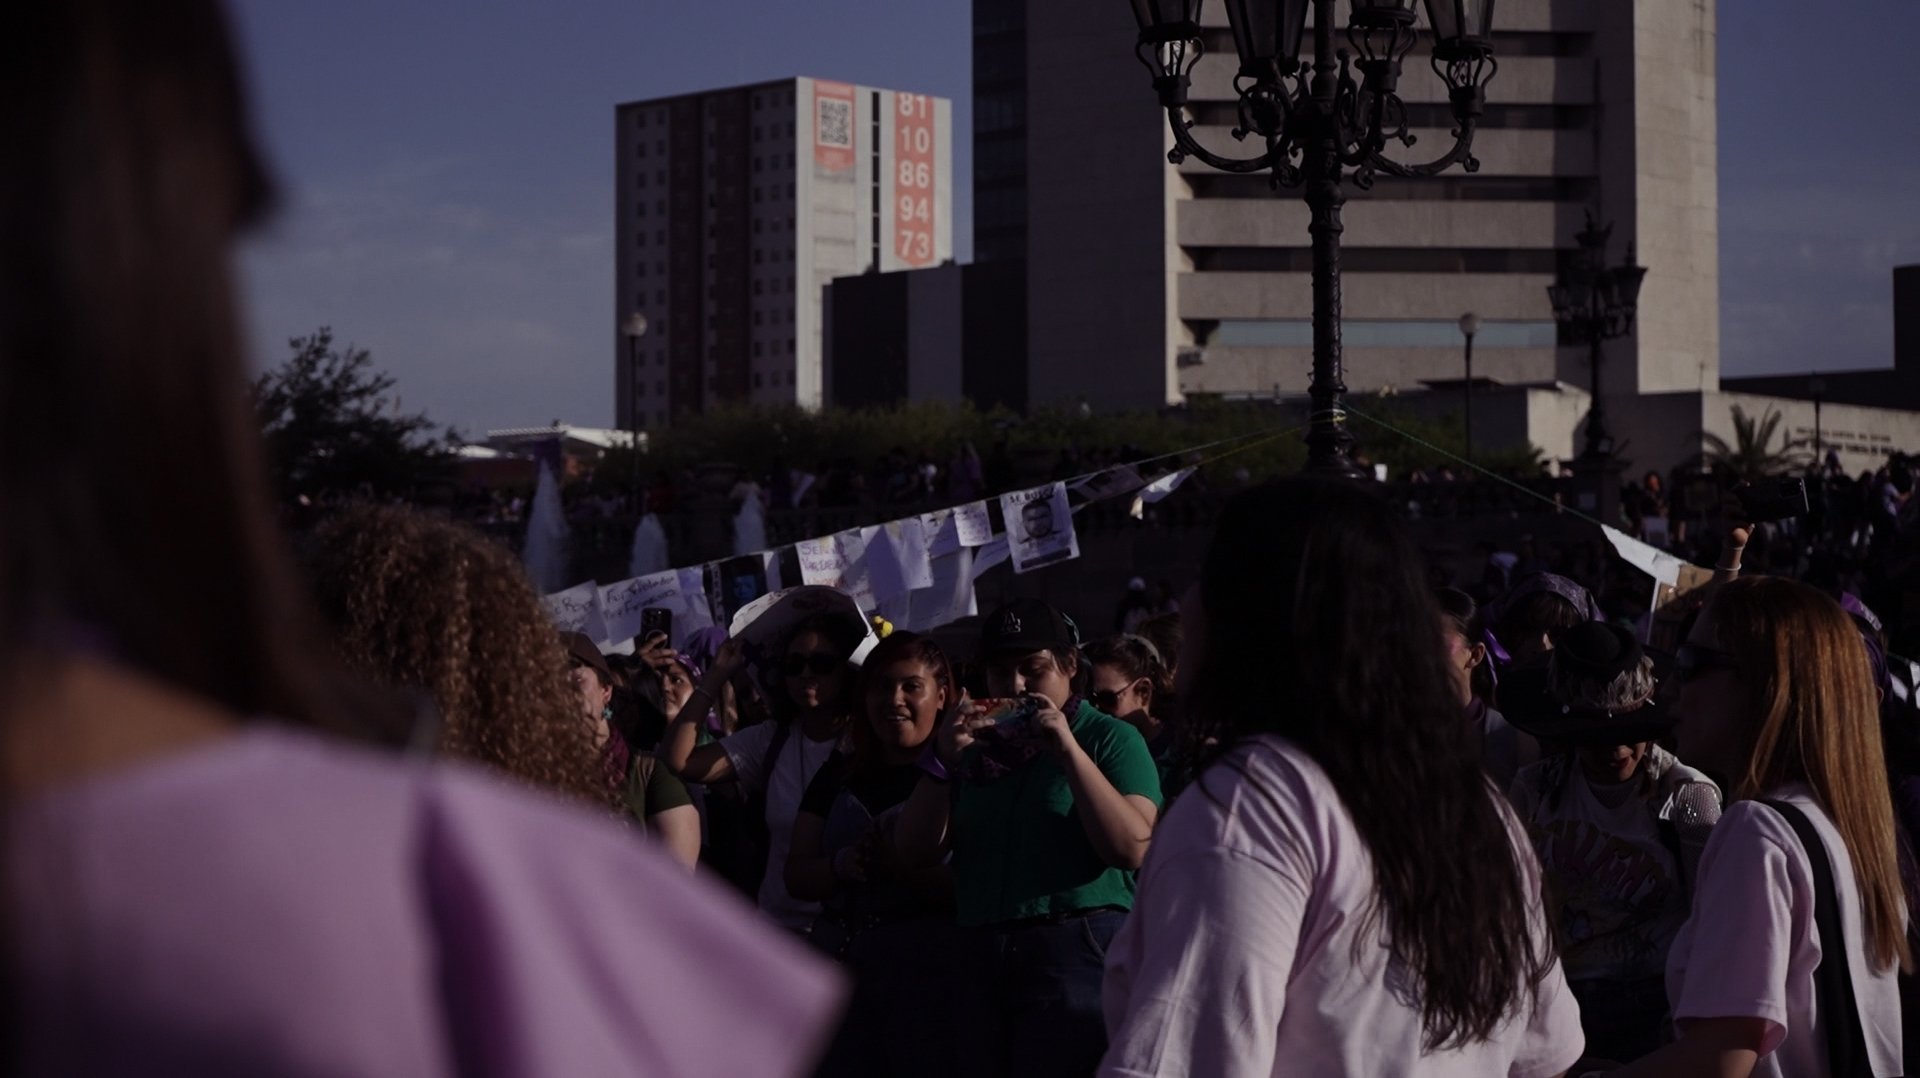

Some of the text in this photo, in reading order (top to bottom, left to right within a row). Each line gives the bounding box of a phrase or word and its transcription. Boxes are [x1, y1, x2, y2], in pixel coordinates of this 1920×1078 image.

[899, 92, 927, 119] 81
[901, 125, 930, 154] 10
[899, 160, 930, 189] 86
[900, 195, 929, 223] 94
[901, 231, 930, 259] 73
